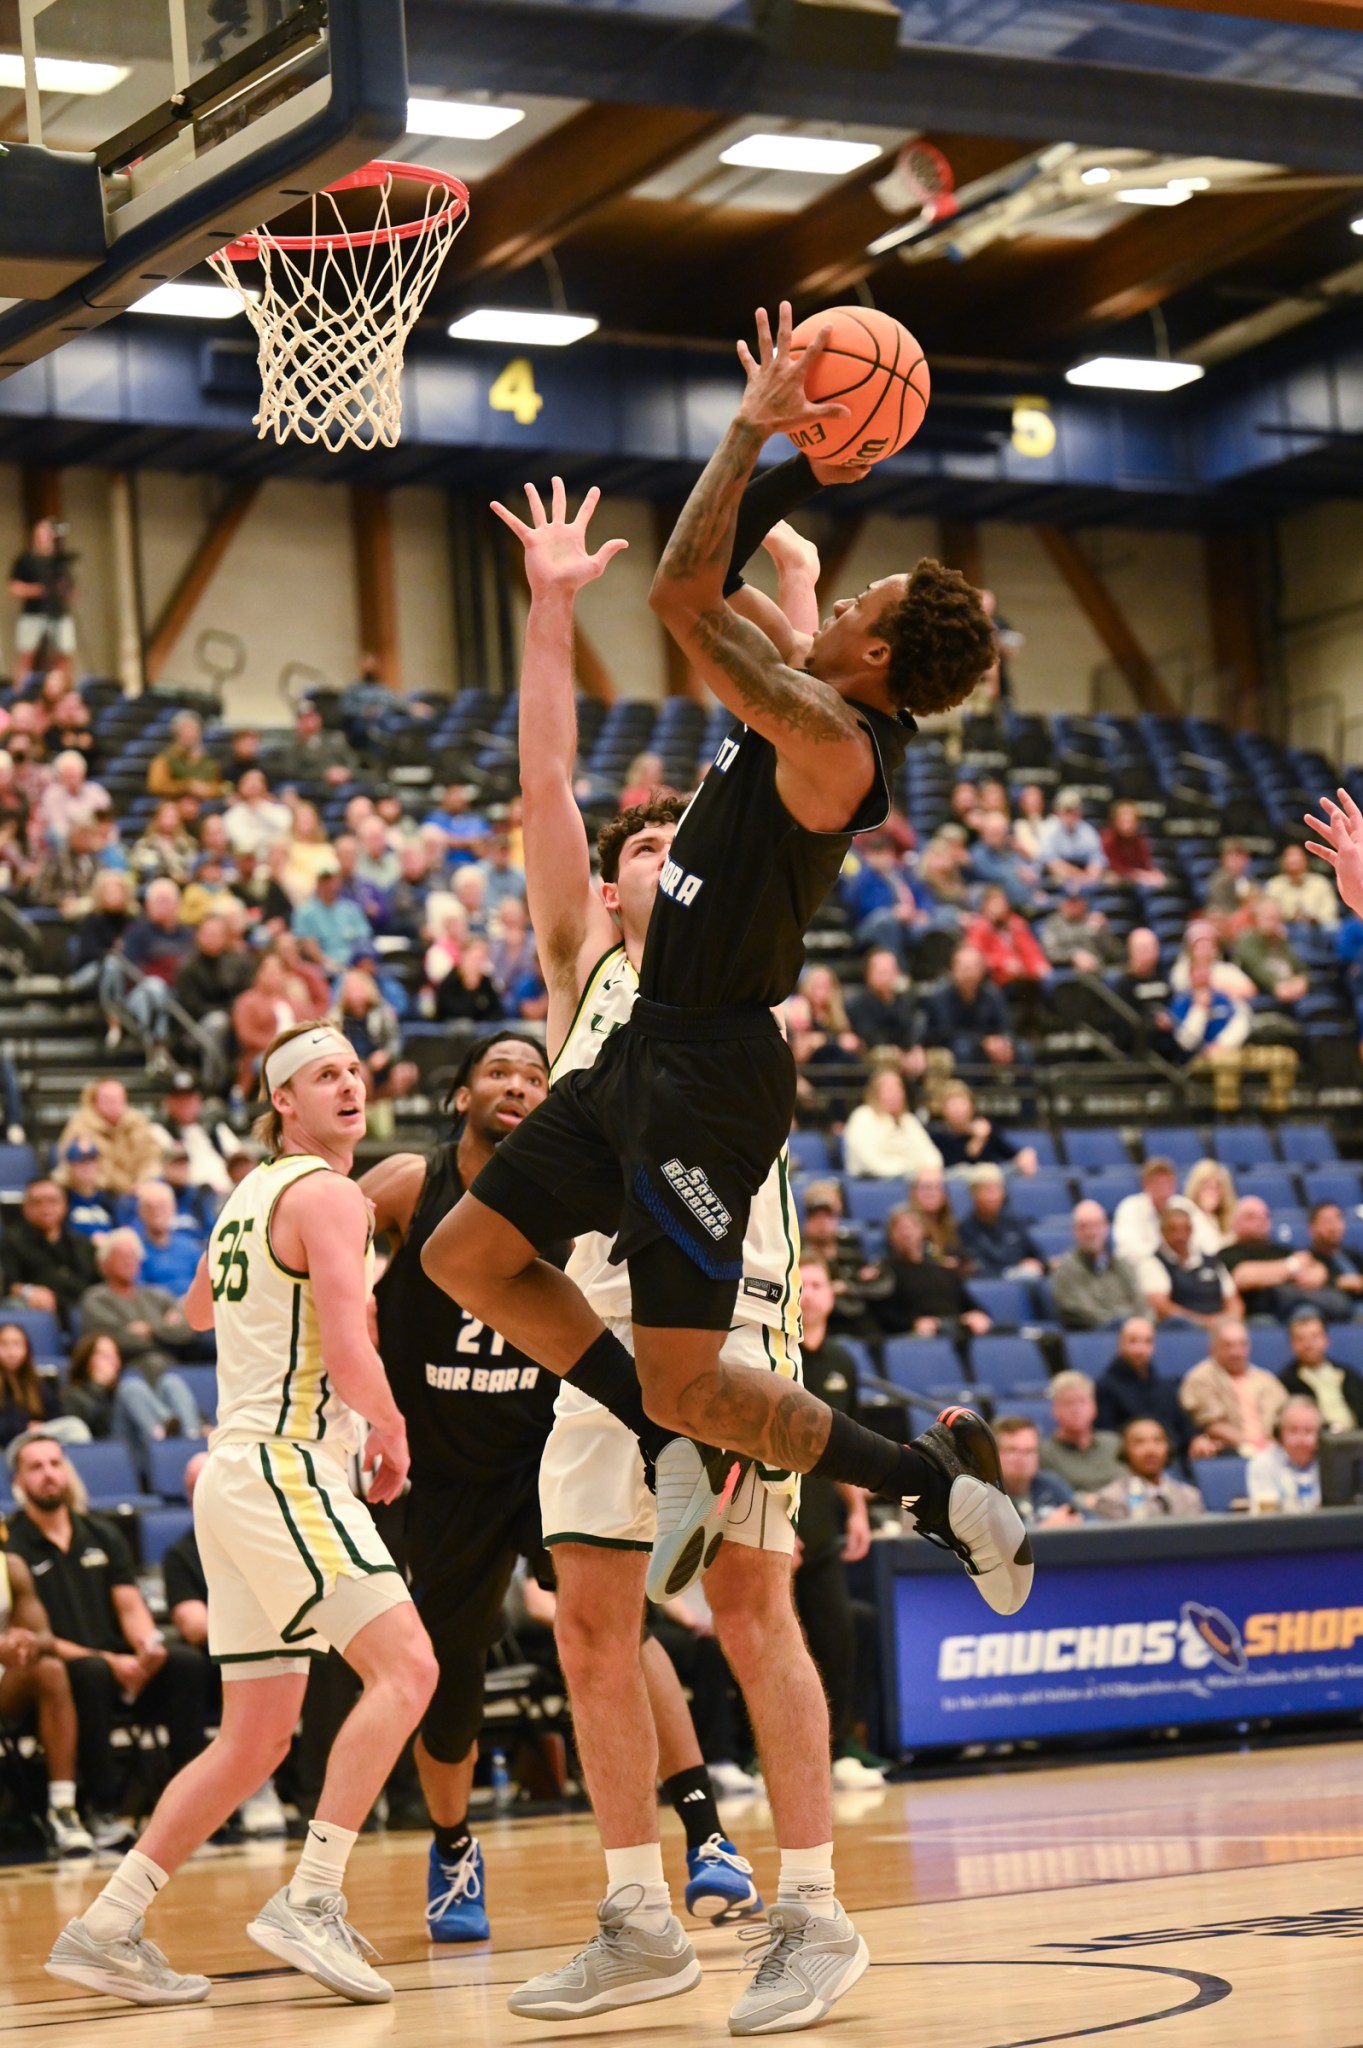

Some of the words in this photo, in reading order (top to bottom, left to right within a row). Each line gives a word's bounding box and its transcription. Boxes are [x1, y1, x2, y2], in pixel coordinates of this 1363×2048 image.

[489, 356, 543, 425] 4
[1012, 395, 1056, 458] 5
[662, 1160, 727, 1238] BARBARA
[684, 1168, 731, 1225] SANTA
[211, 1218, 254, 1302] 35
[770, 1288, 779, 1298] XL
[456, 1309, 505, 1356] 21
[425, 1362, 540, 1393] BARBARA
[938, 1620, 1178, 1681] GAUCHOS
[1242, 1606, 1363, 1657] SHOP
